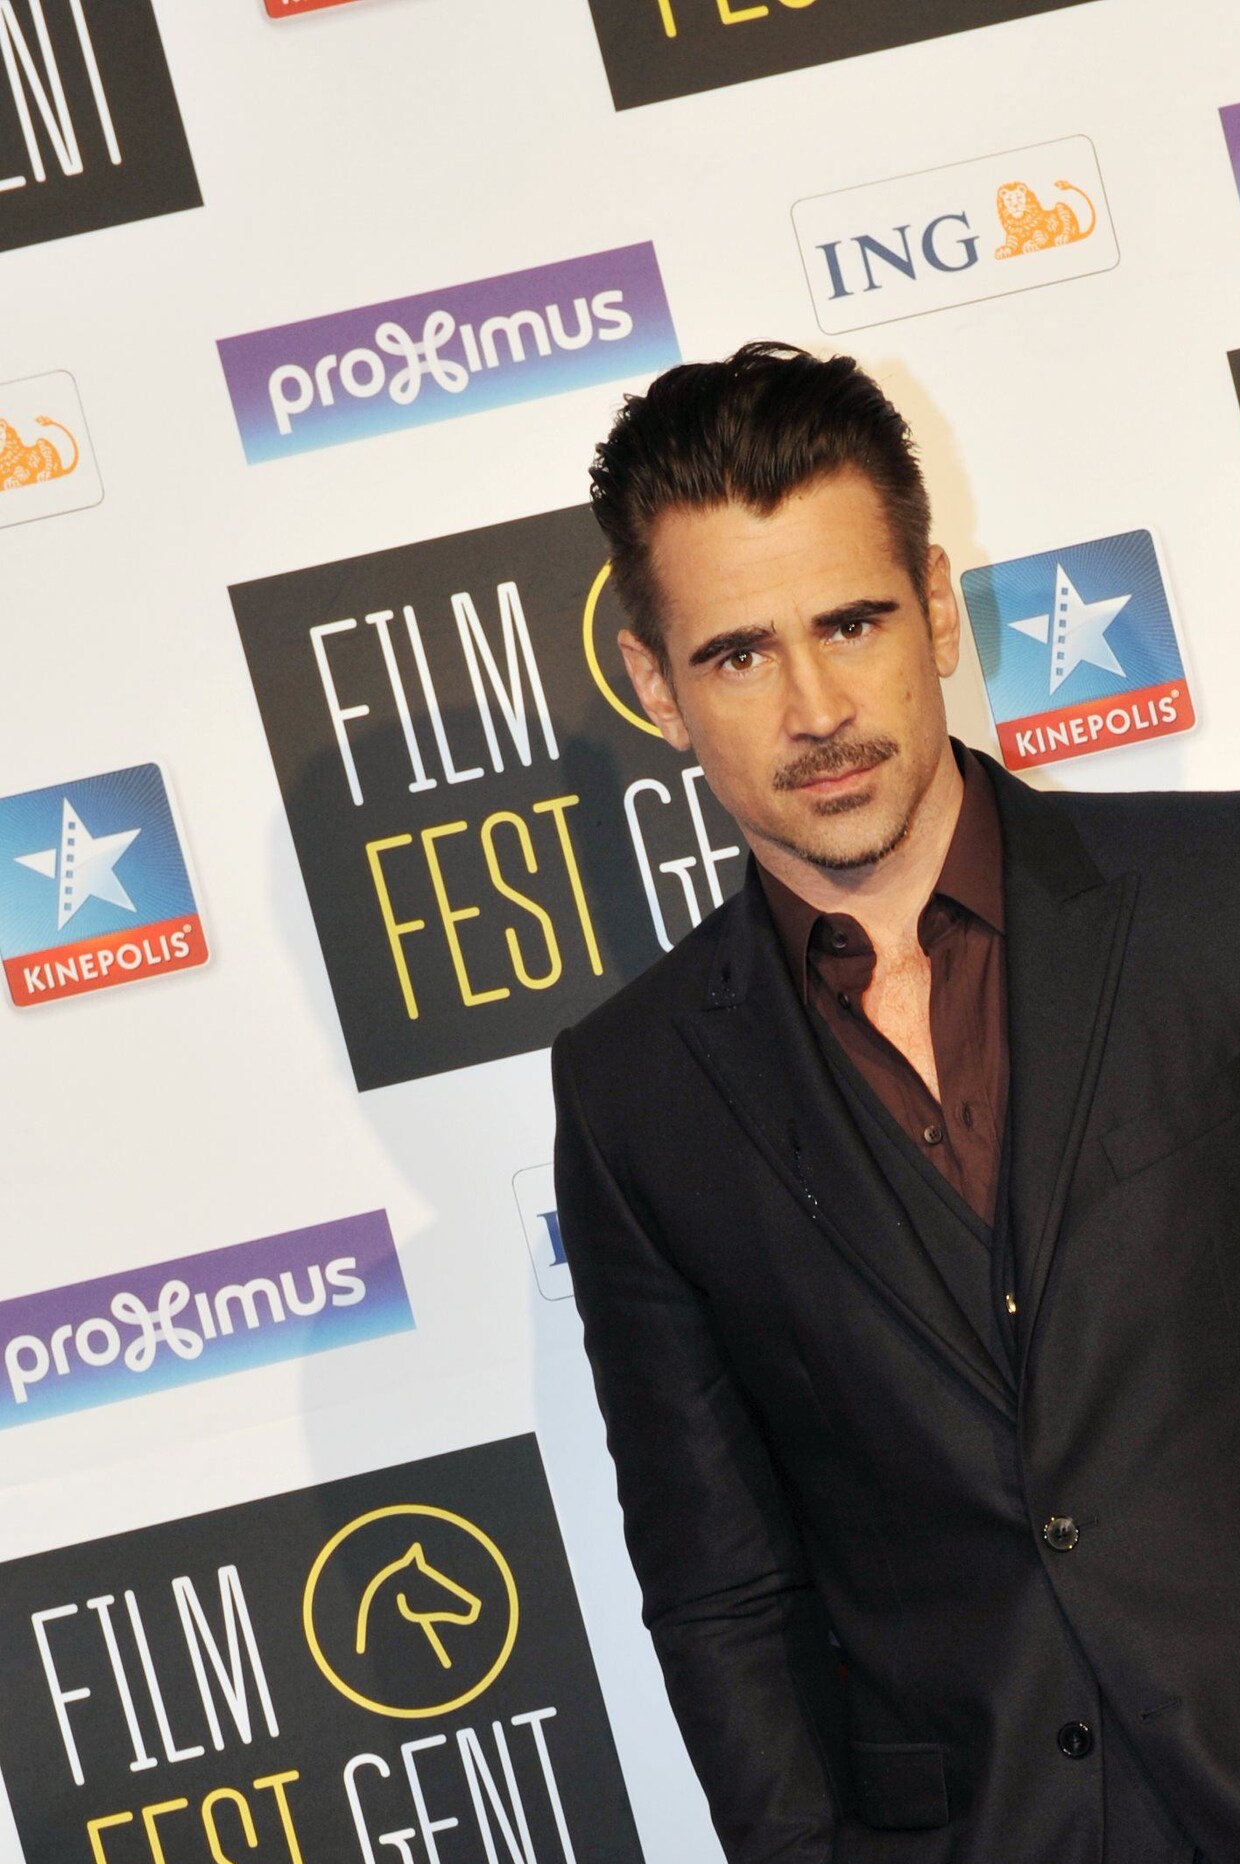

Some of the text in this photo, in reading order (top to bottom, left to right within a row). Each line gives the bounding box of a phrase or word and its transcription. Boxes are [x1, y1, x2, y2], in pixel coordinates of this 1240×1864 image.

[815, 211, 980, 299] ING
[267, 289, 633, 435] proximus
[310, 582, 559, 806] FILM
[366, 795, 603, 1019] FEST
[5, 1257, 366, 1404] proximus
[32, 1565, 279, 1785] FILM
